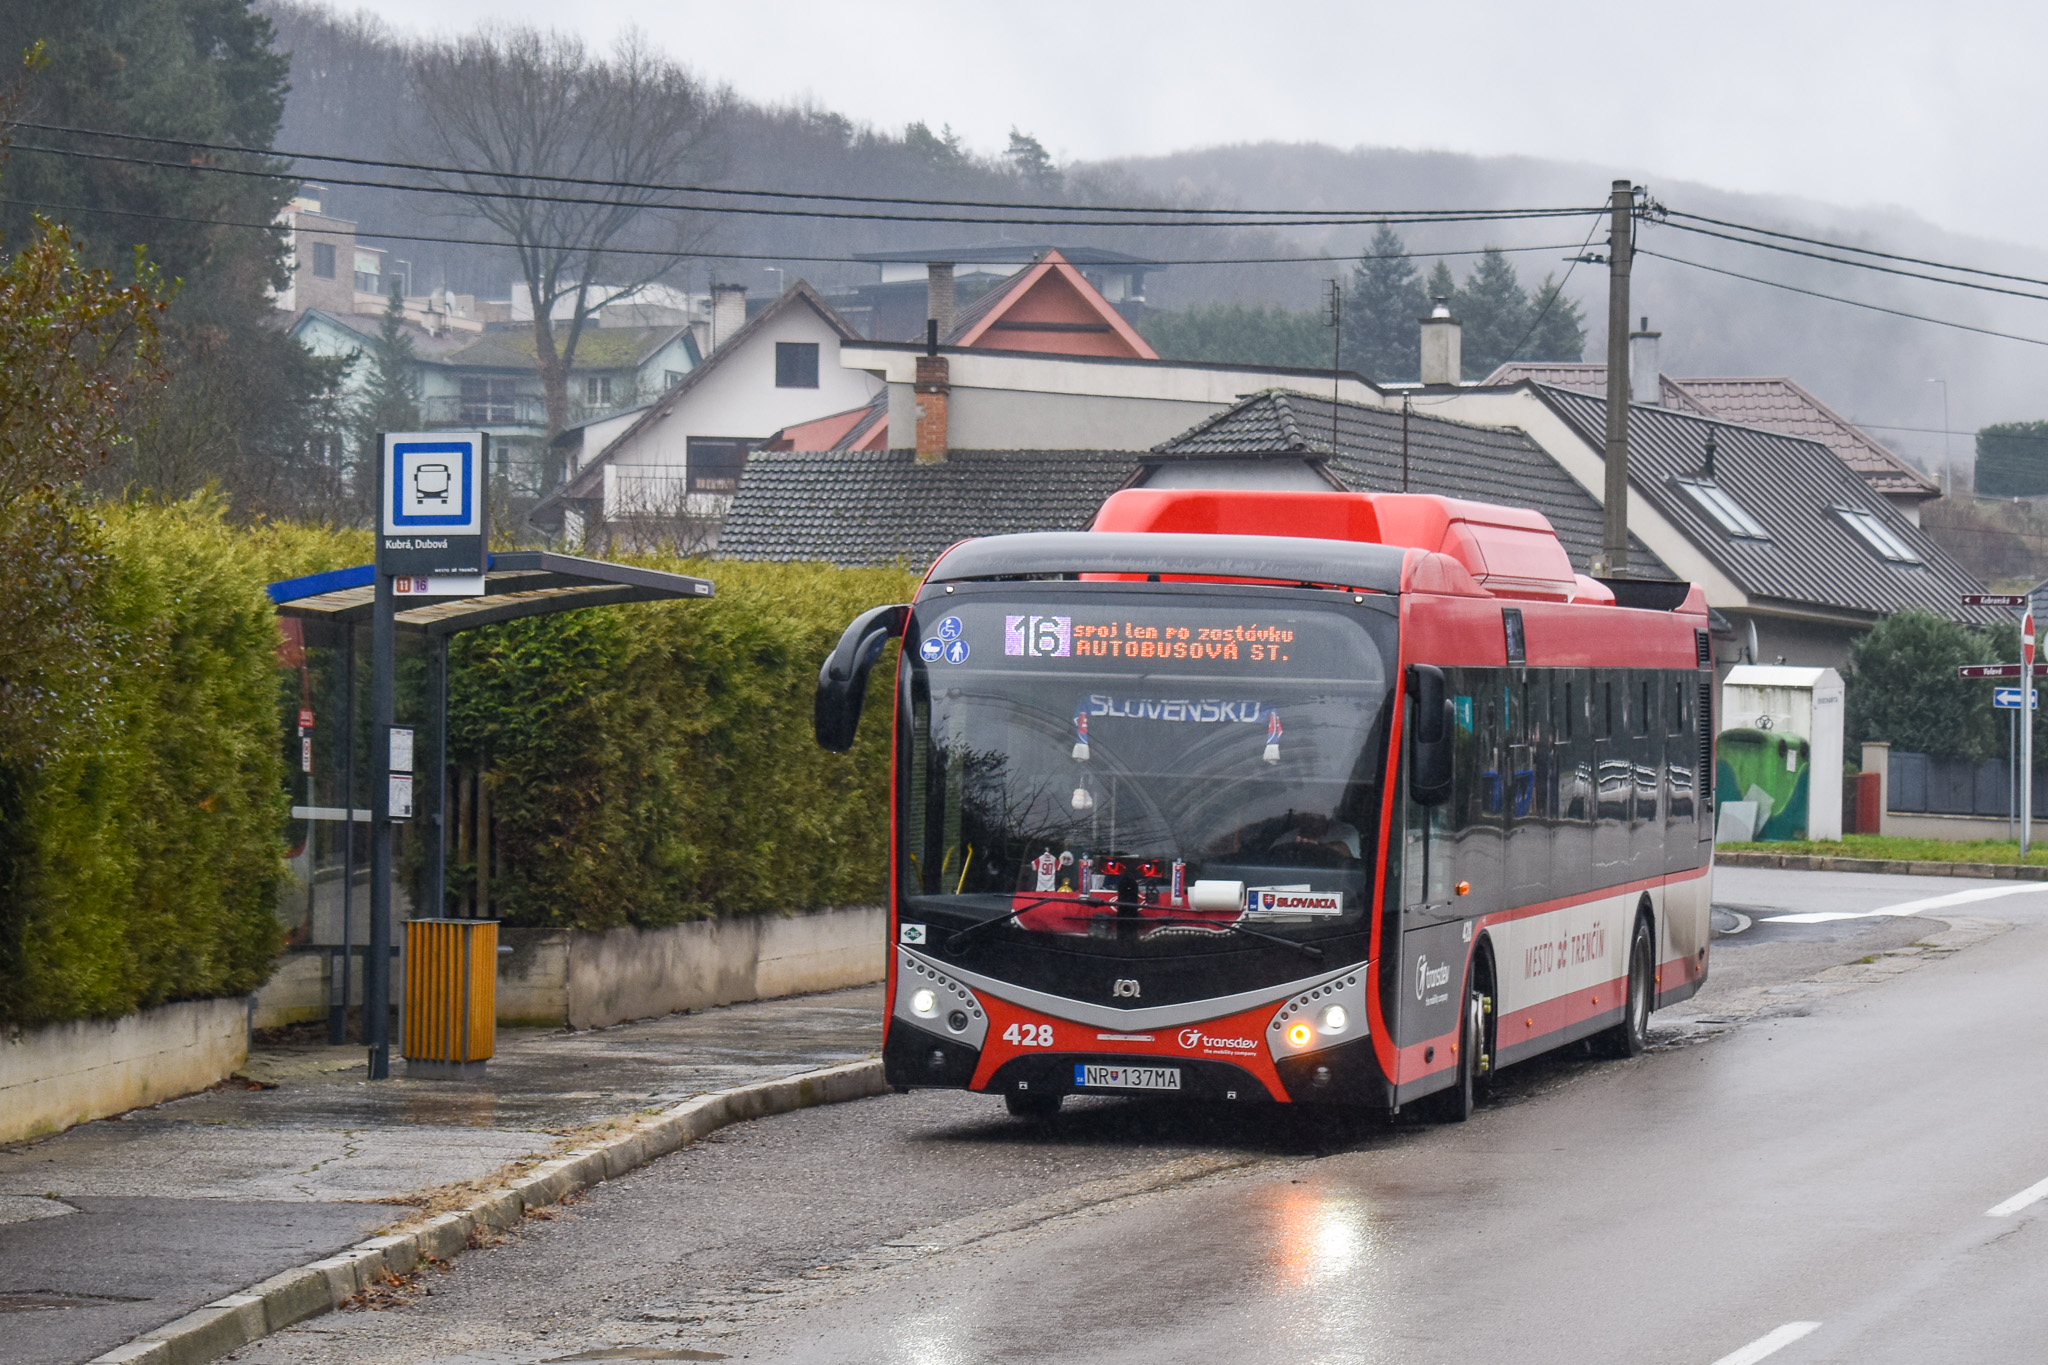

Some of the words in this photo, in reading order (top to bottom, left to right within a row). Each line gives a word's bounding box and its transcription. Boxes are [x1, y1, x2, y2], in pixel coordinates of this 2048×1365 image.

[385, 538, 414, 550] Kubrá,
[415, 538, 448, 549] Dubová
[399, 580, 409, 591] 11
[415, 580, 427, 591] 16
[1008, 615, 1067, 658] 16
[1073, 622, 1118, 638] spoj
[1125, 622, 1158, 639] len
[1165, 627, 1190, 640] po
[1198, 623, 1294, 643] zastávku
[1076, 639, 1239, 660] AUTOBUSOVÁ
[1250, 644, 1289, 661] ST.
[1041, 863, 1054, 876] 90
[1276, 897, 1338, 909] SLOVAKIA
[905, 930, 922, 938] CNG
[1525, 941, 1554, 980] MESTO
[1571, 920, 1605, 966] TRENČÍN
[1002, 1023, 1054, 1047] 428
[1202, 1035, 1258, 1049] transdev
[1086, 1067, 1109, 1085] NR
[1121, 1068, 1178, 1088] 137MA
